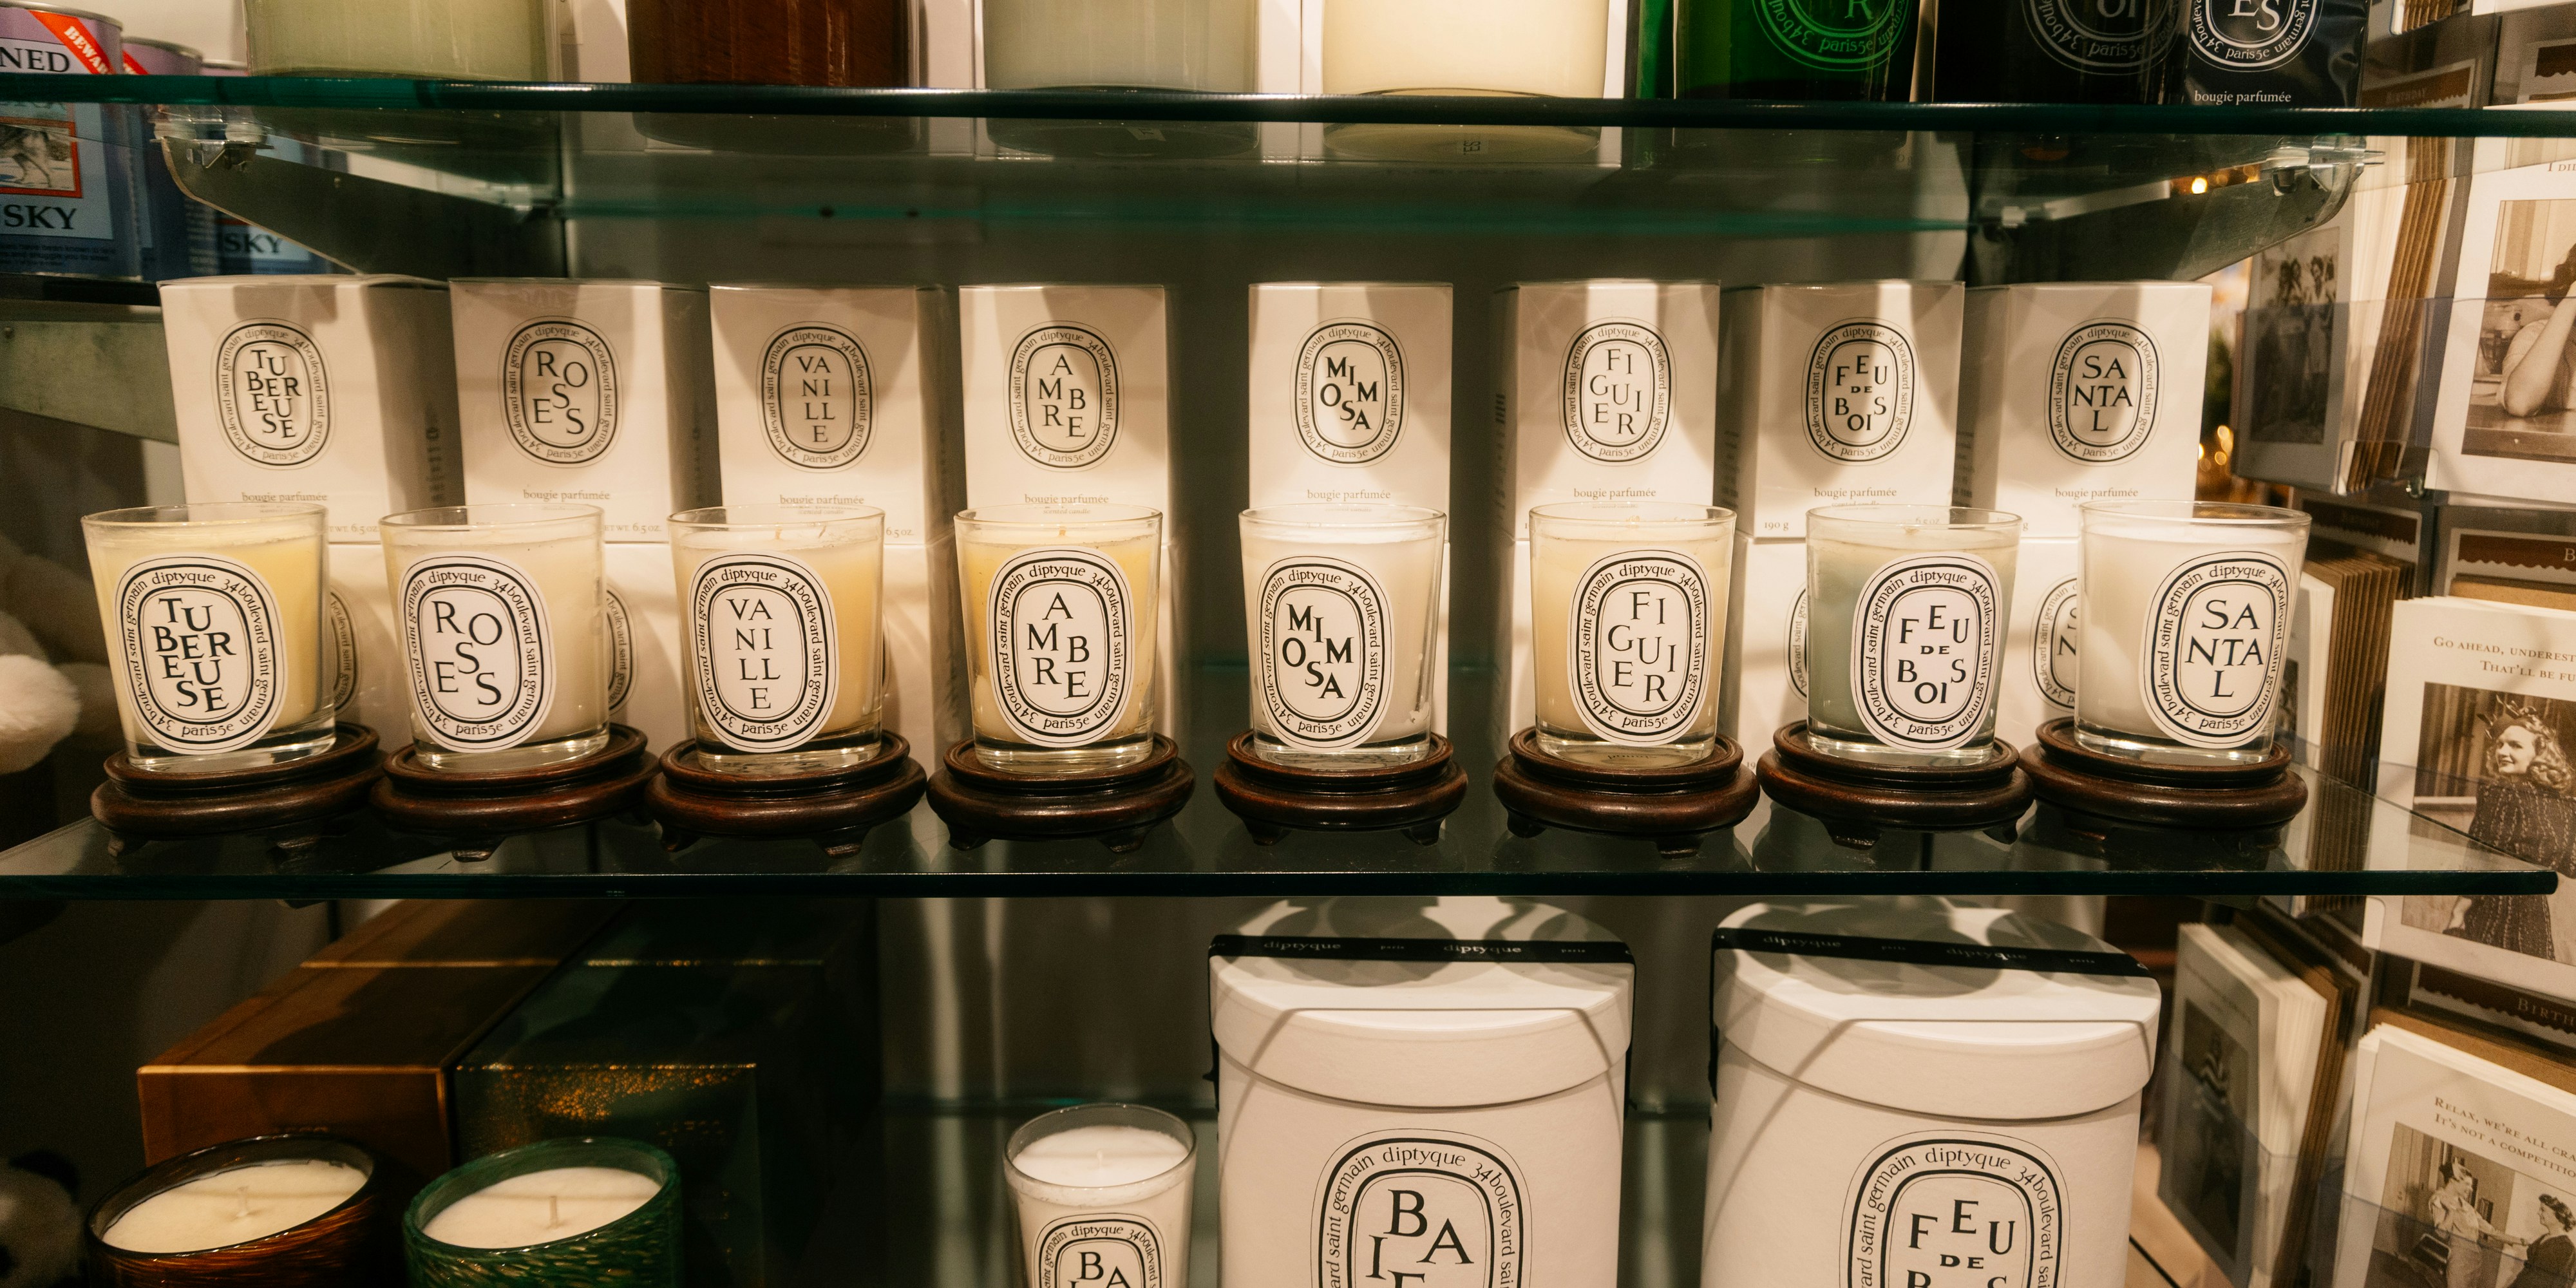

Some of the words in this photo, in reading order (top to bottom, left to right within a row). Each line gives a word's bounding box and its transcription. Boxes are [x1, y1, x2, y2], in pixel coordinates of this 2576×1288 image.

[2226, 48, 2269, 60] paris5e
[2194, 90, 2233, 105] bougie
[2236, 91, 2291, 105] parfumée
[245, 329, 289, 339] diptyque
[535, 327, 580, 337] diptyque
[793, 332, 836, 342] diptyque
[1041, 332, 1084, 341] diptyque
[1329, 328, 1371, 338] diptyque
[1598, 328, 1640, 337] diptyque
[1842, 328, 1884, 338] diptyque
[2087, 328, 2130, 338] diptyque
[1332, 450, 1368, 458] paris5e
[1599, 448, 1634, 457] paris5e
[1841, 448, 1876, 456] paris5e
[2083, 448, 2119, 457] paris5e
[242, 491, 276, 502] bougie
[279, 491, 327, 502] parfumée
[523, 489, 558, 502] bougie
[561, 489, 611, 502] parfumée
[1025, 493, 1058, 504] bougie
[1061, 493, 1108, 504] parfumée
[1307, 489, 1340, 501] bougie
[1343, 489, 1390, 501] parfumée
[1574, 488, 1607, 500] bougie
[1610, 488, 1656, 500] parfumée
[1814, 488, 1847, 499] bougie
[1850, 487, 1897, 499] parfumée
[2055, 488, 2088, 500] bougie
[2091, 488, 2138, 499] parfumée
[780, 495, 813, 504] bougie
[817, 495, 864, 504] parfumée
[632, 523, 646, 533] 6.5
[1783, 522, 1789, 531] g
[721, 569, 777, 582] diptyque
[1029, 565, 1086, 578] diptyque
[1620, 564, 1674, 576] diptyque
[2210, 565, 2266, 578] diptyque
[151, 572, 216, 585] diptyque
[428, 571, 486, 584] diptyque
[1289, 570, 1341, 583] diptyque
[1911, 571, 1967, 583] diptyque
[2458, 643, 2505, 655] AHEAD,
[2540, 670, 2554, 679] BE
[1043, 717, 1090, 729] paris5e
[1298, 721, 1342, 734] paris5e
[1622, 715, 1668, 728] paris5e
[2199, 717, 2245, 729] paris5e
[182, 723, 234, 737] paris5e
[455, 723, 504, 735] paris5e
[741, 723, 788, 734] paris5e
[1907, 723, 1954, 736] paris5e
[1264, 940, 1341, 952] diptyque
[1443, 943, 1522, 954] diptyque
[2461, 1126, 2485, 1140] NOT
[2525, 1136, 2548, 1150] ALL
[1383, 1147, 1466, 1167] diptyque
[1925, 1148, 2011, 1169] diptyque
[1072, 1226, 1123, 1237] diptyque
[1940, 1254, 1984, 1269] DE
